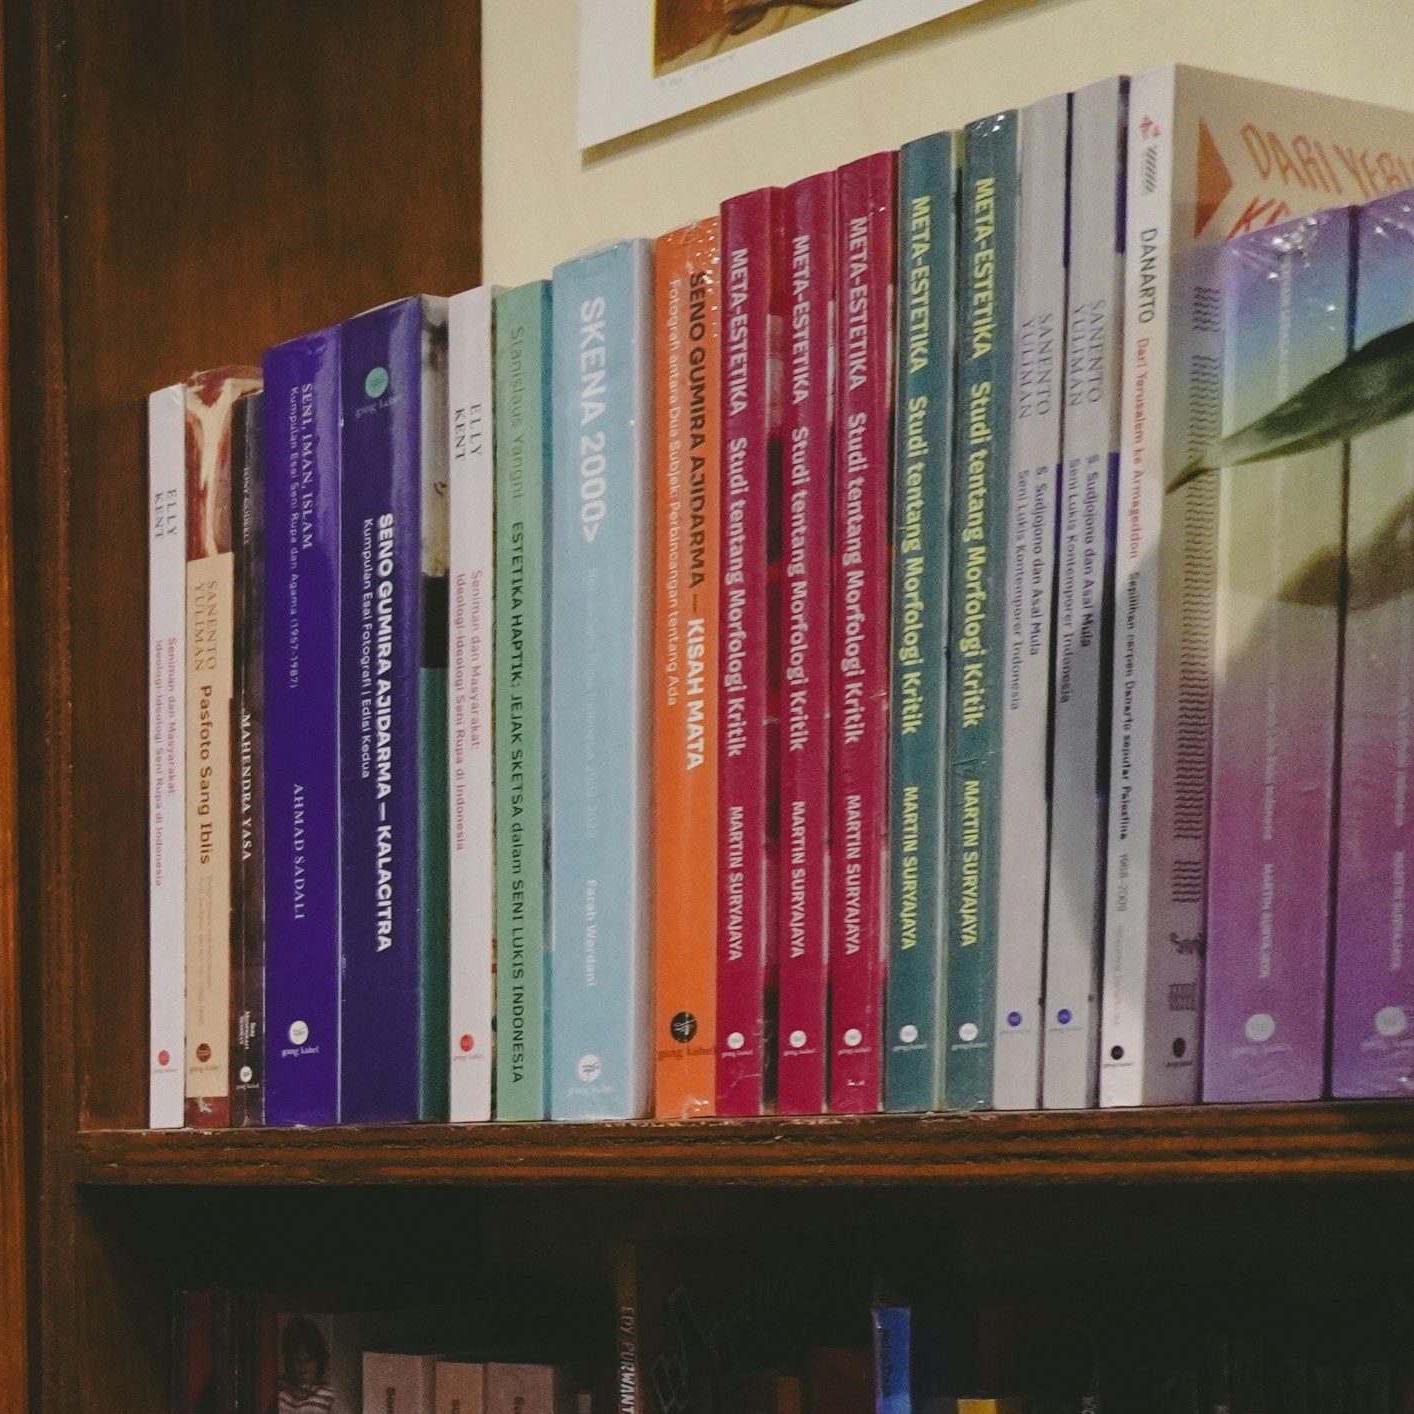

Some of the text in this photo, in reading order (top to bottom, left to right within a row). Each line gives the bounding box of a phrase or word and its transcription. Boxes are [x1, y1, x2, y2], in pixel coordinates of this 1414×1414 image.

[1241, 122, 1340, 196] DARI
[1136, 227, 1158, 325] DANARTO
[579, 296, 607, 426] SKENA
[300, 382, 315, 550] SENI, IMAN, ISLAM
[193, 583, 206, 672] YULIMAN
[206, 579, 218, 670] SANENTO
[723, 248, 749, 962] META-ESTETIKA Studi tentang Morfologi Kritik MARTIN SURYAJAYA
[960, 178, 996, 949] META-ESTETIKA Studi tentang Morfologi Kritik MARTIN SURYAJAYA
[375, 512, 395, 953] SENO GUMIRA AJIDARMA KALACITRA
[508, 325, 526, 1084] Stanislaus Yangni ESTETIKA HAPTIK: JEJAK SKETSA dalam SENI LUKIS INDONESIA
[685, 617, 706, 771] KISAH MATA
[198, 684, 214, 865] Pasfoto Sang Iblis
[240, 712, 253, 861] MAHENDRA YASA
[292, 783, 306, 921] AHMAD SADALI
